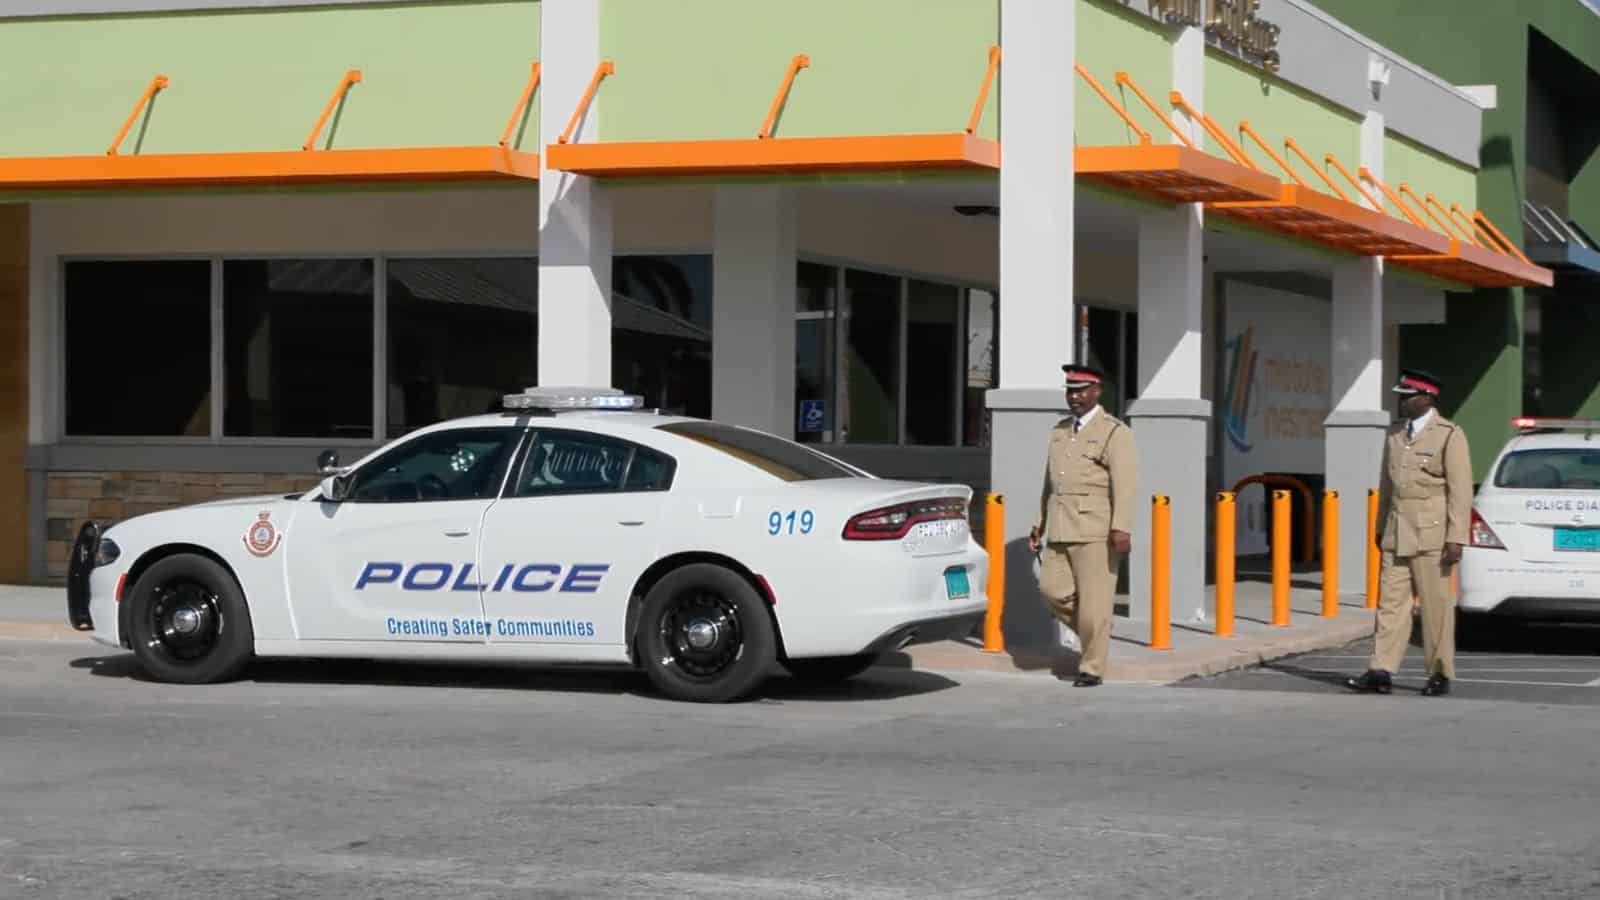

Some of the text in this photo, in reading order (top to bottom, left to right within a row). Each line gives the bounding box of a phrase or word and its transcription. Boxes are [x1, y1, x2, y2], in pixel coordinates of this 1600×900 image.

[1526, 500, 1573, 511] POLICE
[768, 509, 814, 536] 919
[354, 562, 610, 593] POLICE
[386, 617, 594, 637] Creating Safer Communities
